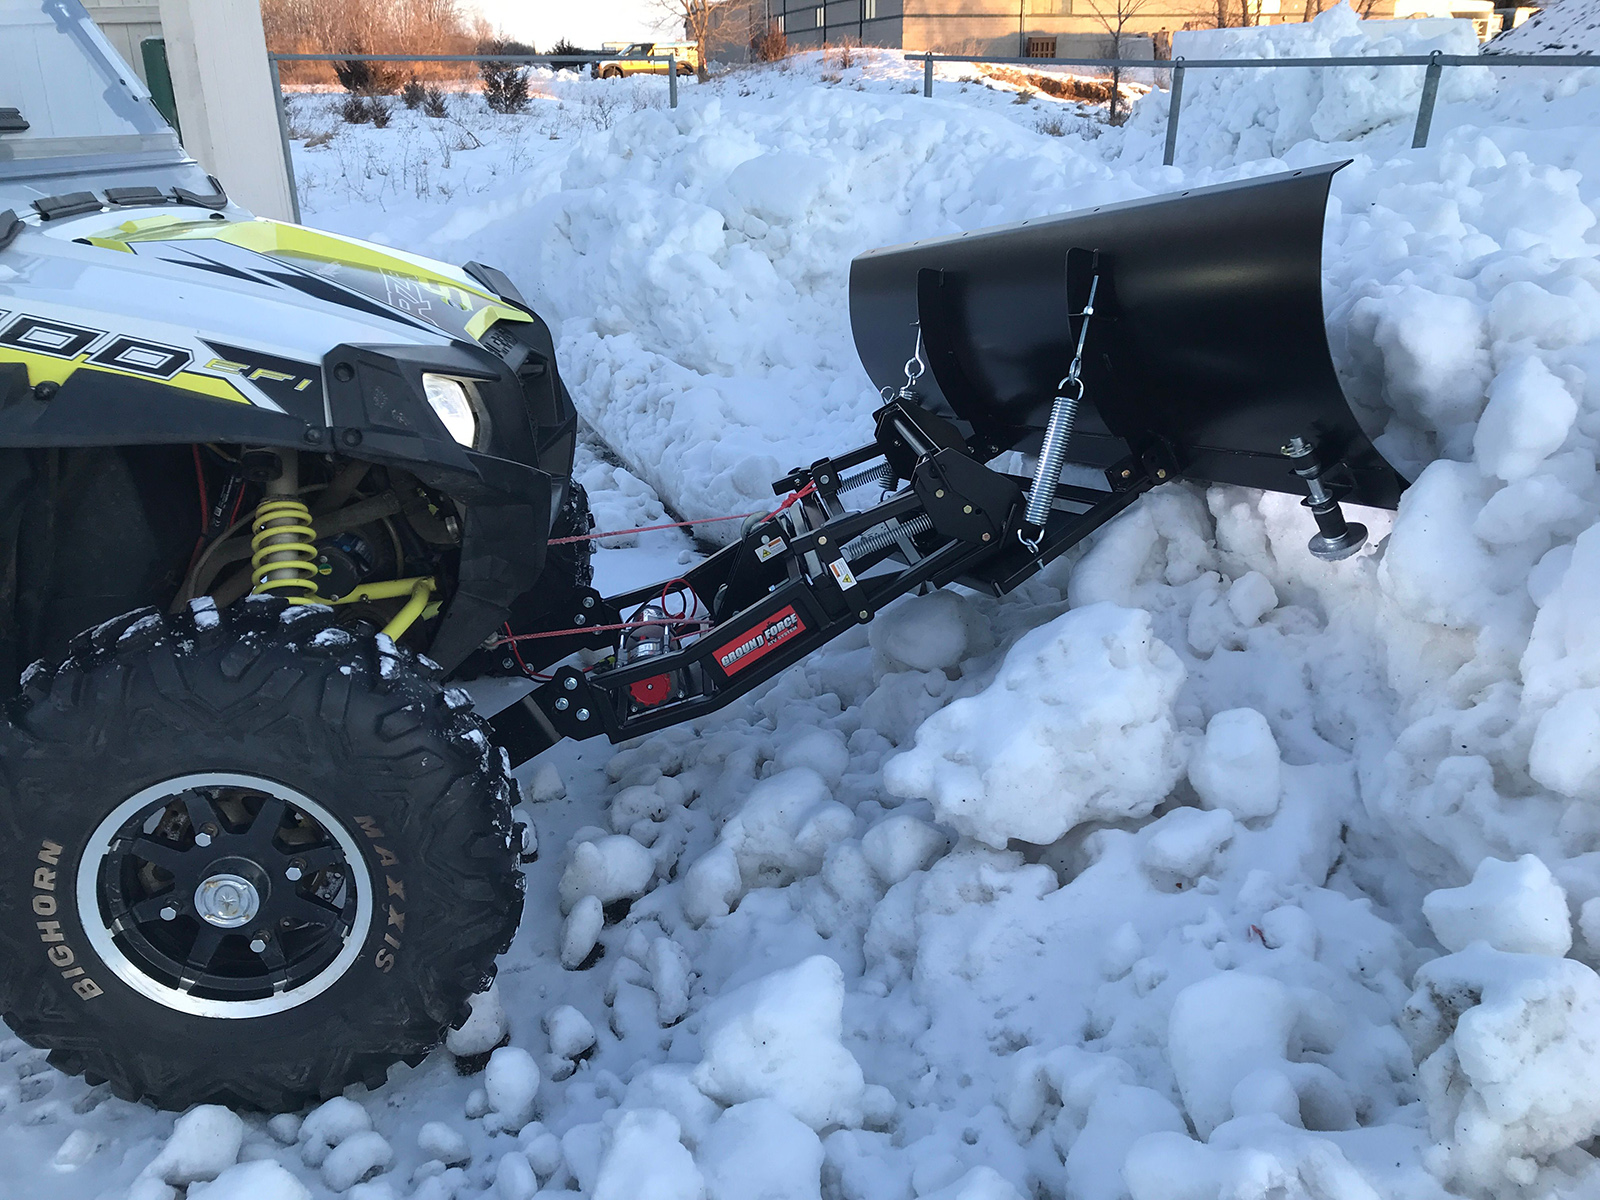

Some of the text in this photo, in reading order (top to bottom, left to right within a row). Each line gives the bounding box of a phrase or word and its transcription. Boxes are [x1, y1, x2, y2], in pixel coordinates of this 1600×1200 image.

[0, 309, 313, 392] 00 EFI
[720, 612, 798, 668] GROUND FORCE
[32, 839, 104, 1001] BIGHORN
[353, 815, 405, 974] MAXXIS
